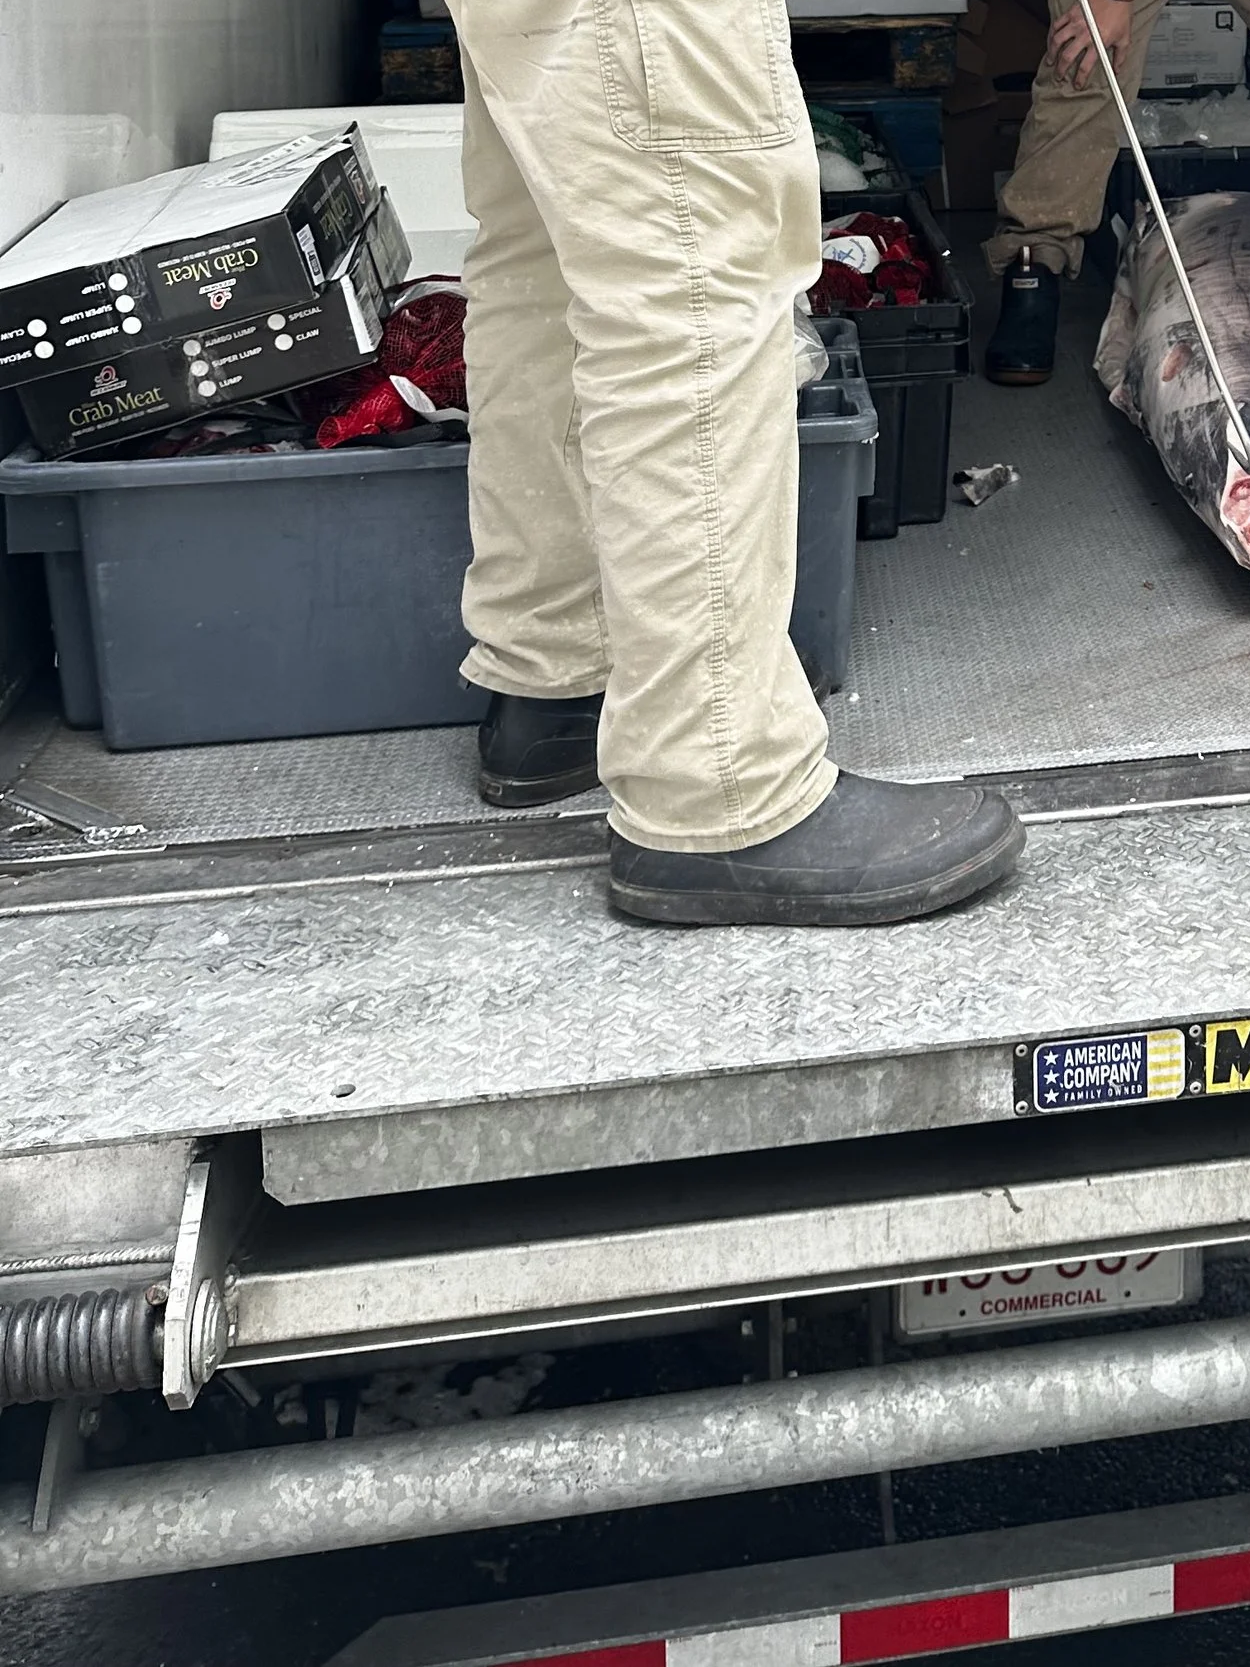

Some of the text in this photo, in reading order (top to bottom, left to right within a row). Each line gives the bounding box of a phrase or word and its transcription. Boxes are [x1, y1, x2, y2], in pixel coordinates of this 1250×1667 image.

[213, 248, 259, 274] Crab
[162, 260, 213, 286] Meat
[82, 282, 106, 294] LUMP
[60, 304, 113, 324] SUPER LUMP
[288, 306, 322, 321] SPECIAL
[0, 328, 25, 341] CLAW
[65, 326, 119, 347] JUMBO LUMP
[205, 326, 257, 348] JUMBO LUMP
[296, 329, 320, 341] CLAW
[212, 347, 263, 367] SUPER LUMP
[219, 375, 243, 388] LUMP
[69, 400, 113, 426] Crab
[114, 387, 164, 413] Meat
[1063, 1040, 1142, 1068] AMERICAN
[1063, 1061, 1142, 1090] COMPANY
[1064, 1084, 1143, 1103] FAMILY OWNED
[980, 1288, 1107, 1316] COMMERCIAL
